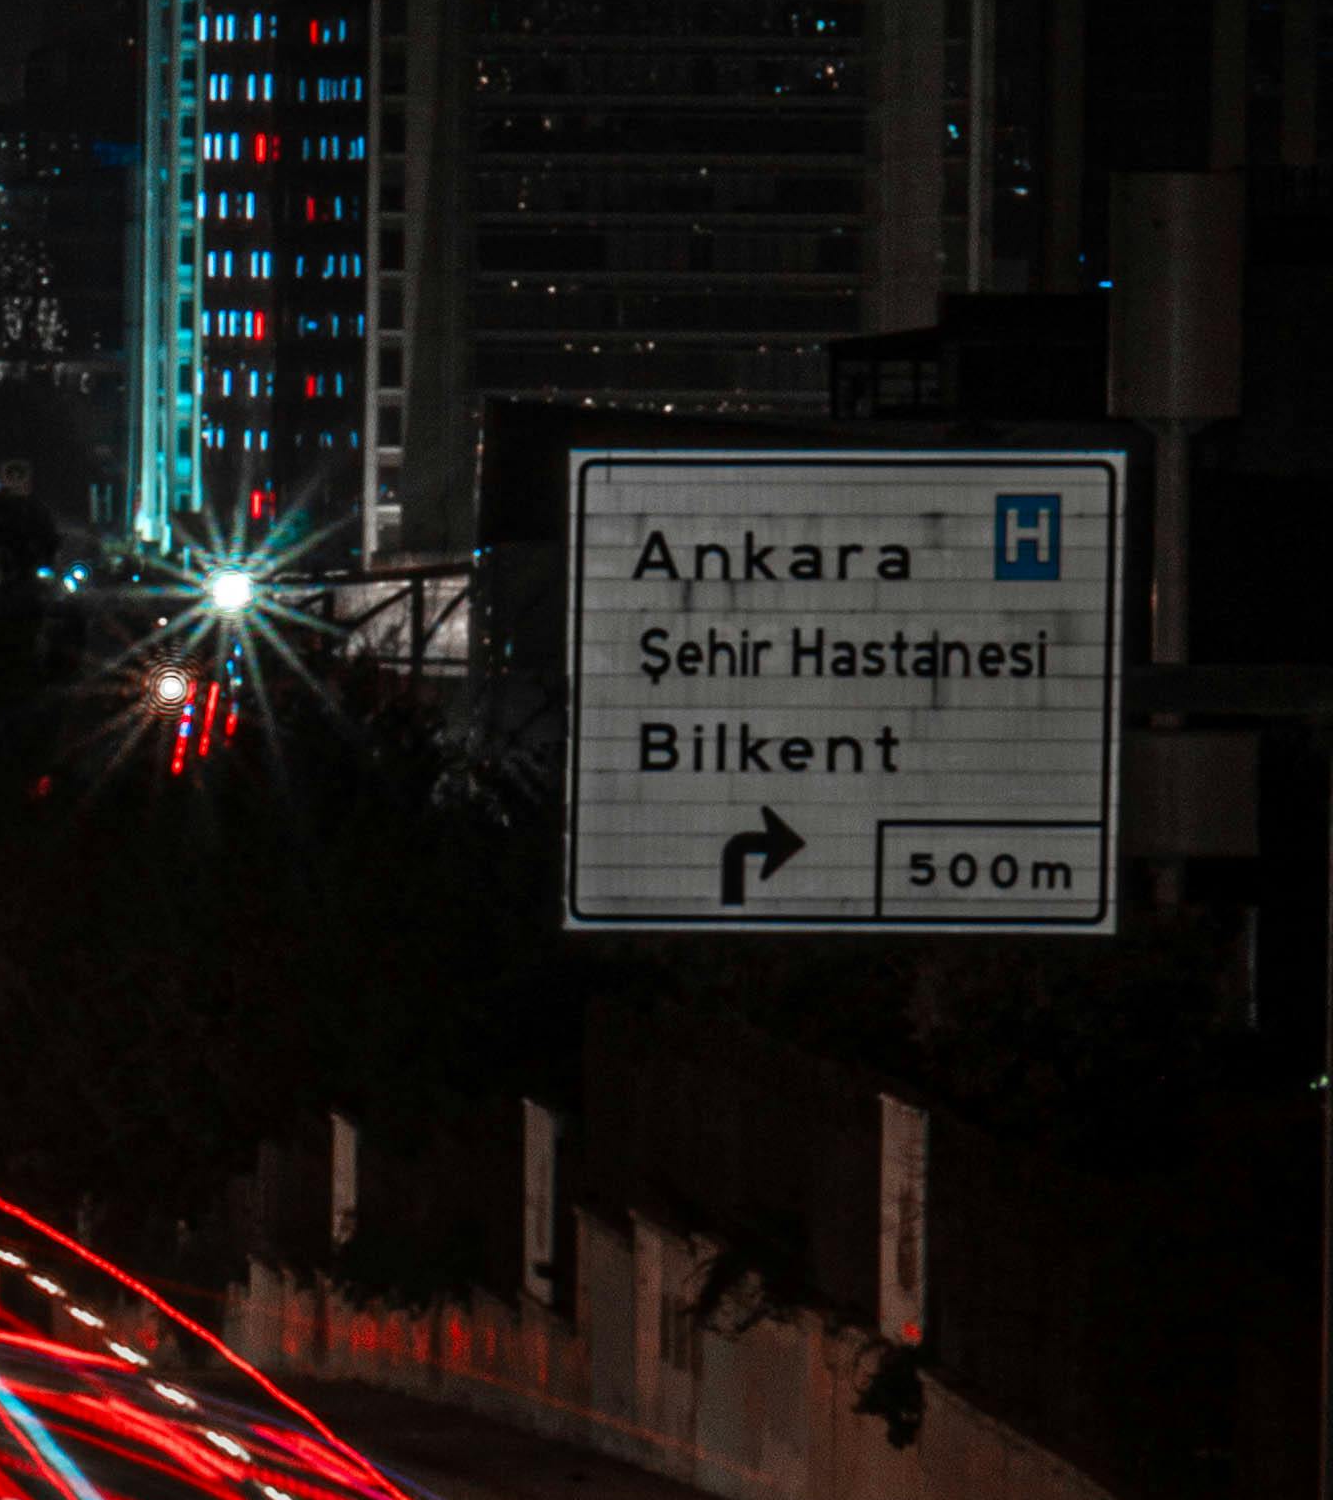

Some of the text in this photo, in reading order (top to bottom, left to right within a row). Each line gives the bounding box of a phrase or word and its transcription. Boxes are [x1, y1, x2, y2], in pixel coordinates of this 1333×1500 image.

[633, 506, 1051, 582] Ankara H
[639, 627, 1048, 685] Şehir Hastanesi
[639, 722, 900, 774] Bilkent
[907, 852, 1073, 889] 500m
